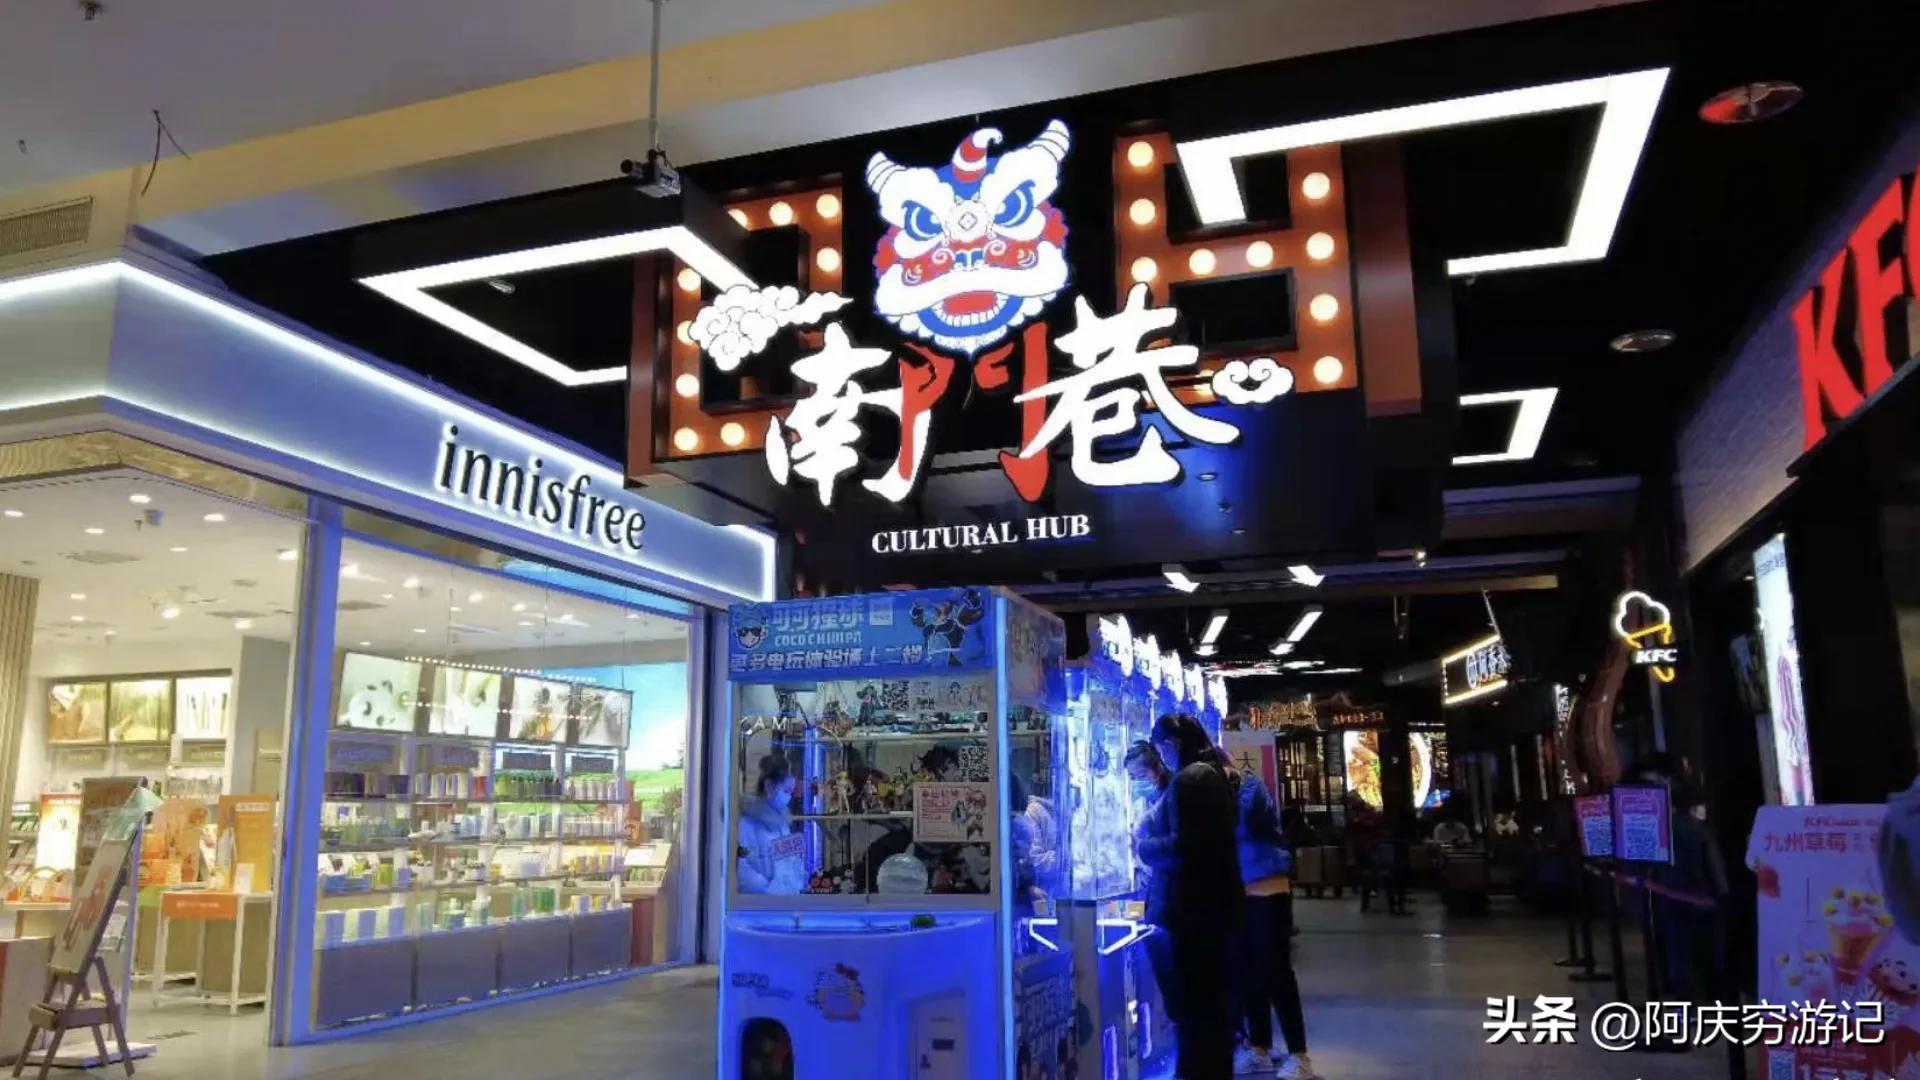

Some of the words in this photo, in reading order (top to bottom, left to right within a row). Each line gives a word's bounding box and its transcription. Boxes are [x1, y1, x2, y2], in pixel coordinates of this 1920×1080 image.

[1791, 153, 1920, 452] KF
[440, 425, 646, 550] innisfree
[872, 522, 1018, 553] CULTURAL
[1026, 514, 1090, 540] HUB
[1636, 649, 1677, 663] KFC
[1764, 831, 1847, 853] 九州草莓
